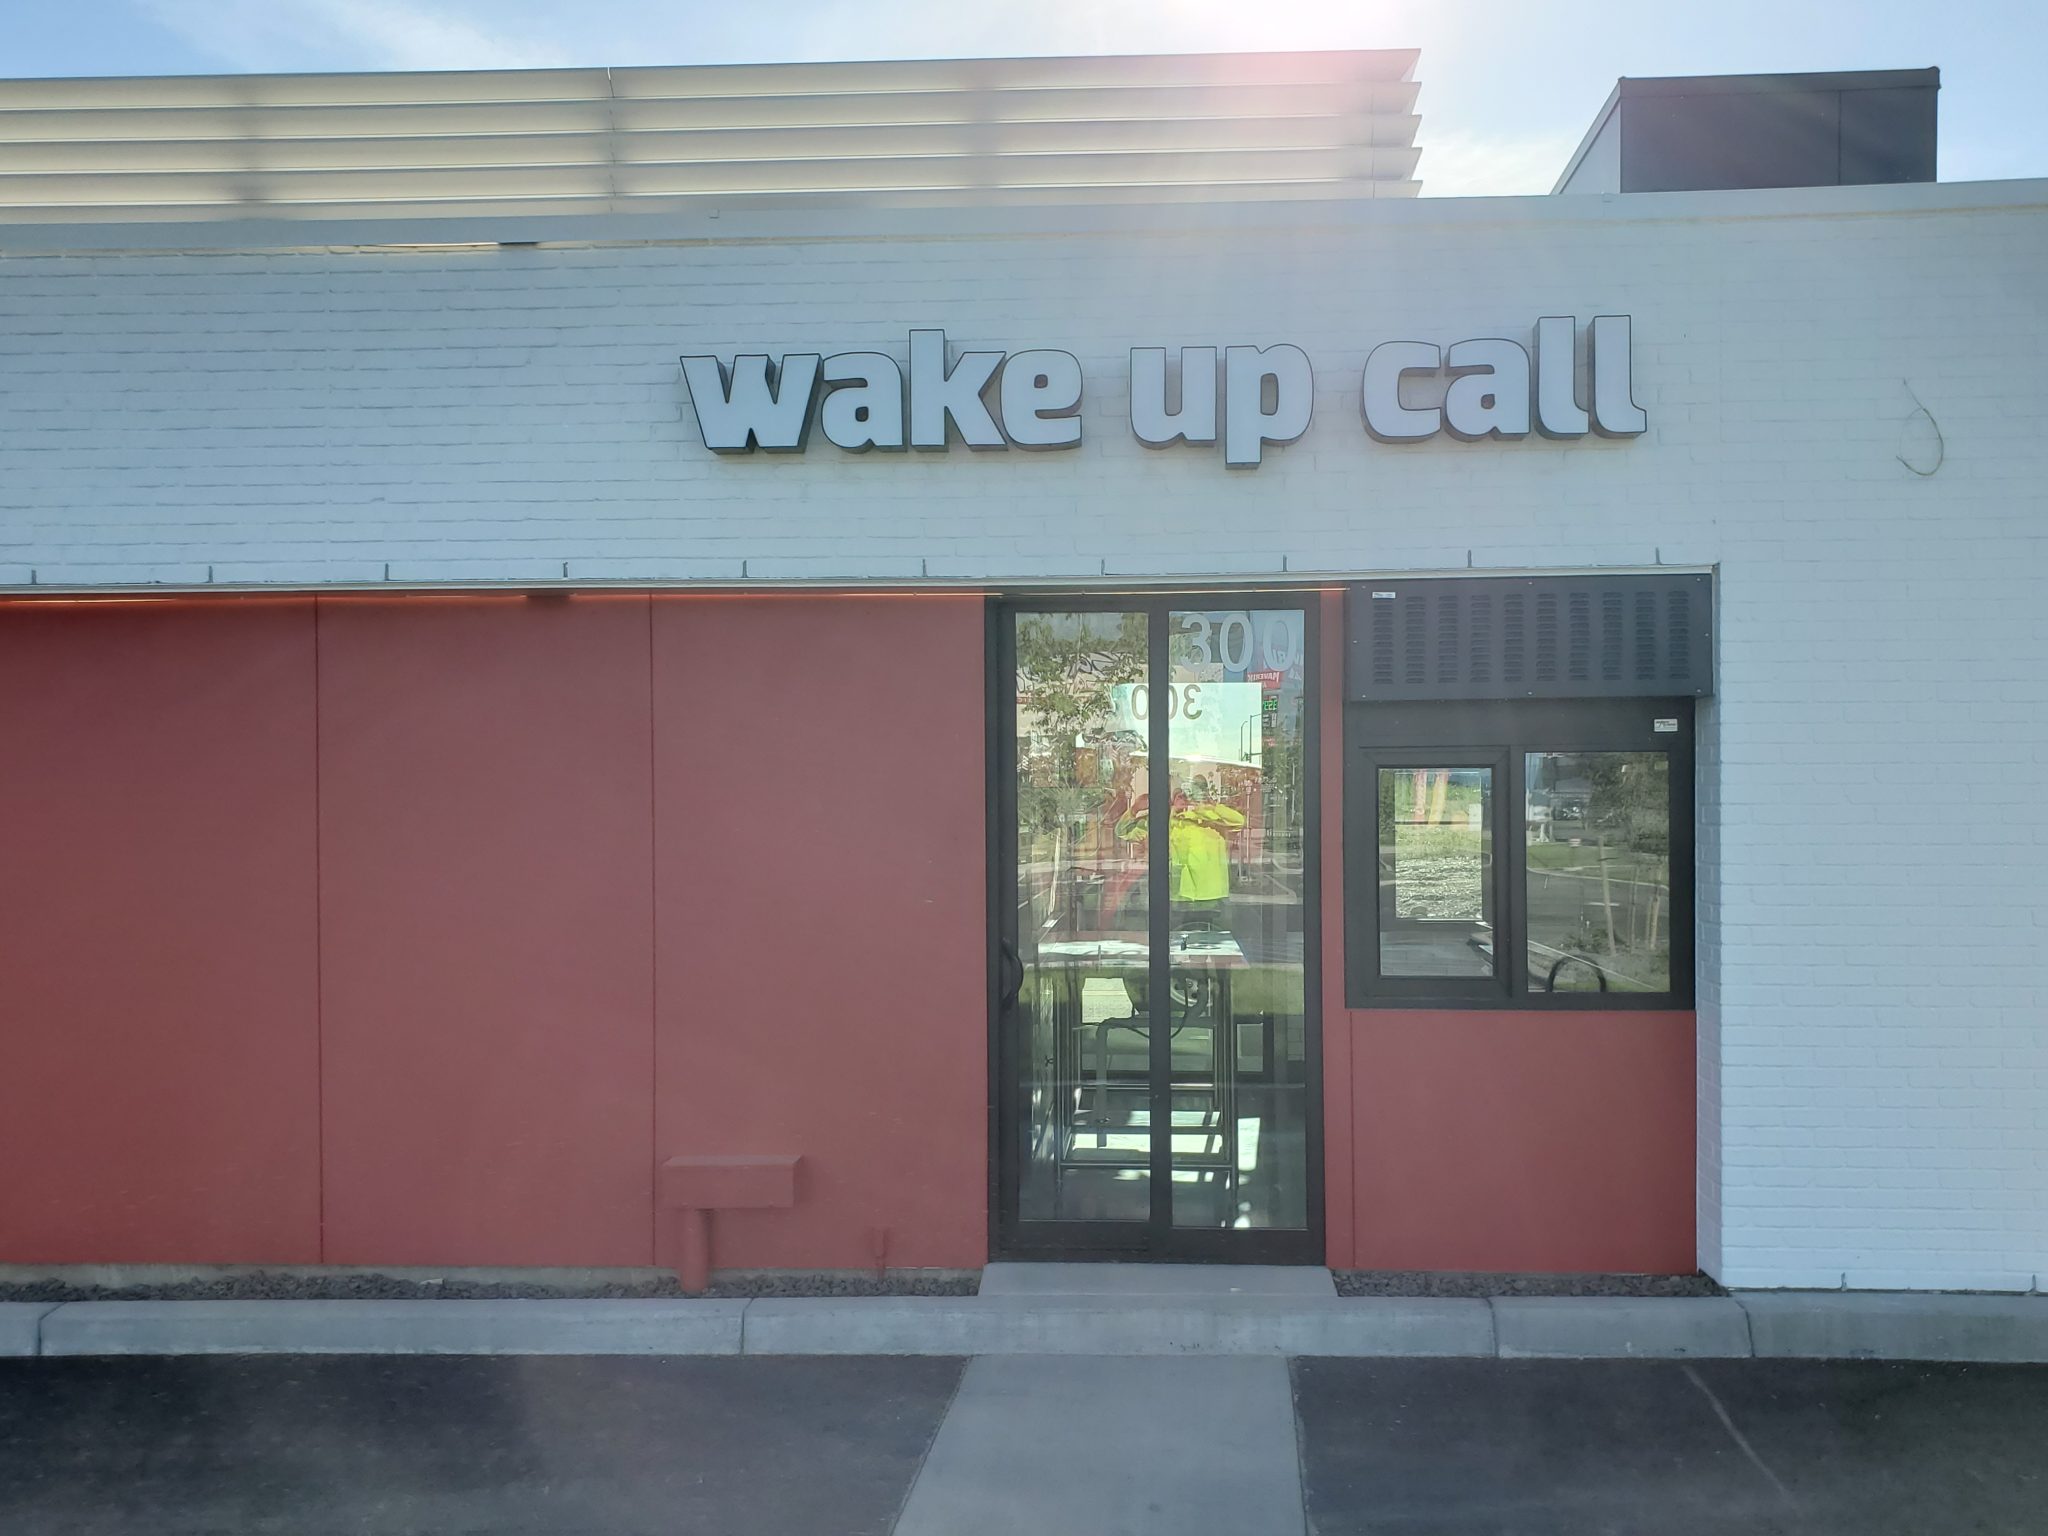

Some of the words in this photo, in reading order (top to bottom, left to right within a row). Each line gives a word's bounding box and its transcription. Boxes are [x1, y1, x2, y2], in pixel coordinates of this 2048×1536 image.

[680, 329, 1083, 453] wake
[1130, 344, 1314, 467] up
[1362, 315, 1647, 444] call
[1181, 613, 1297, 673] 300
